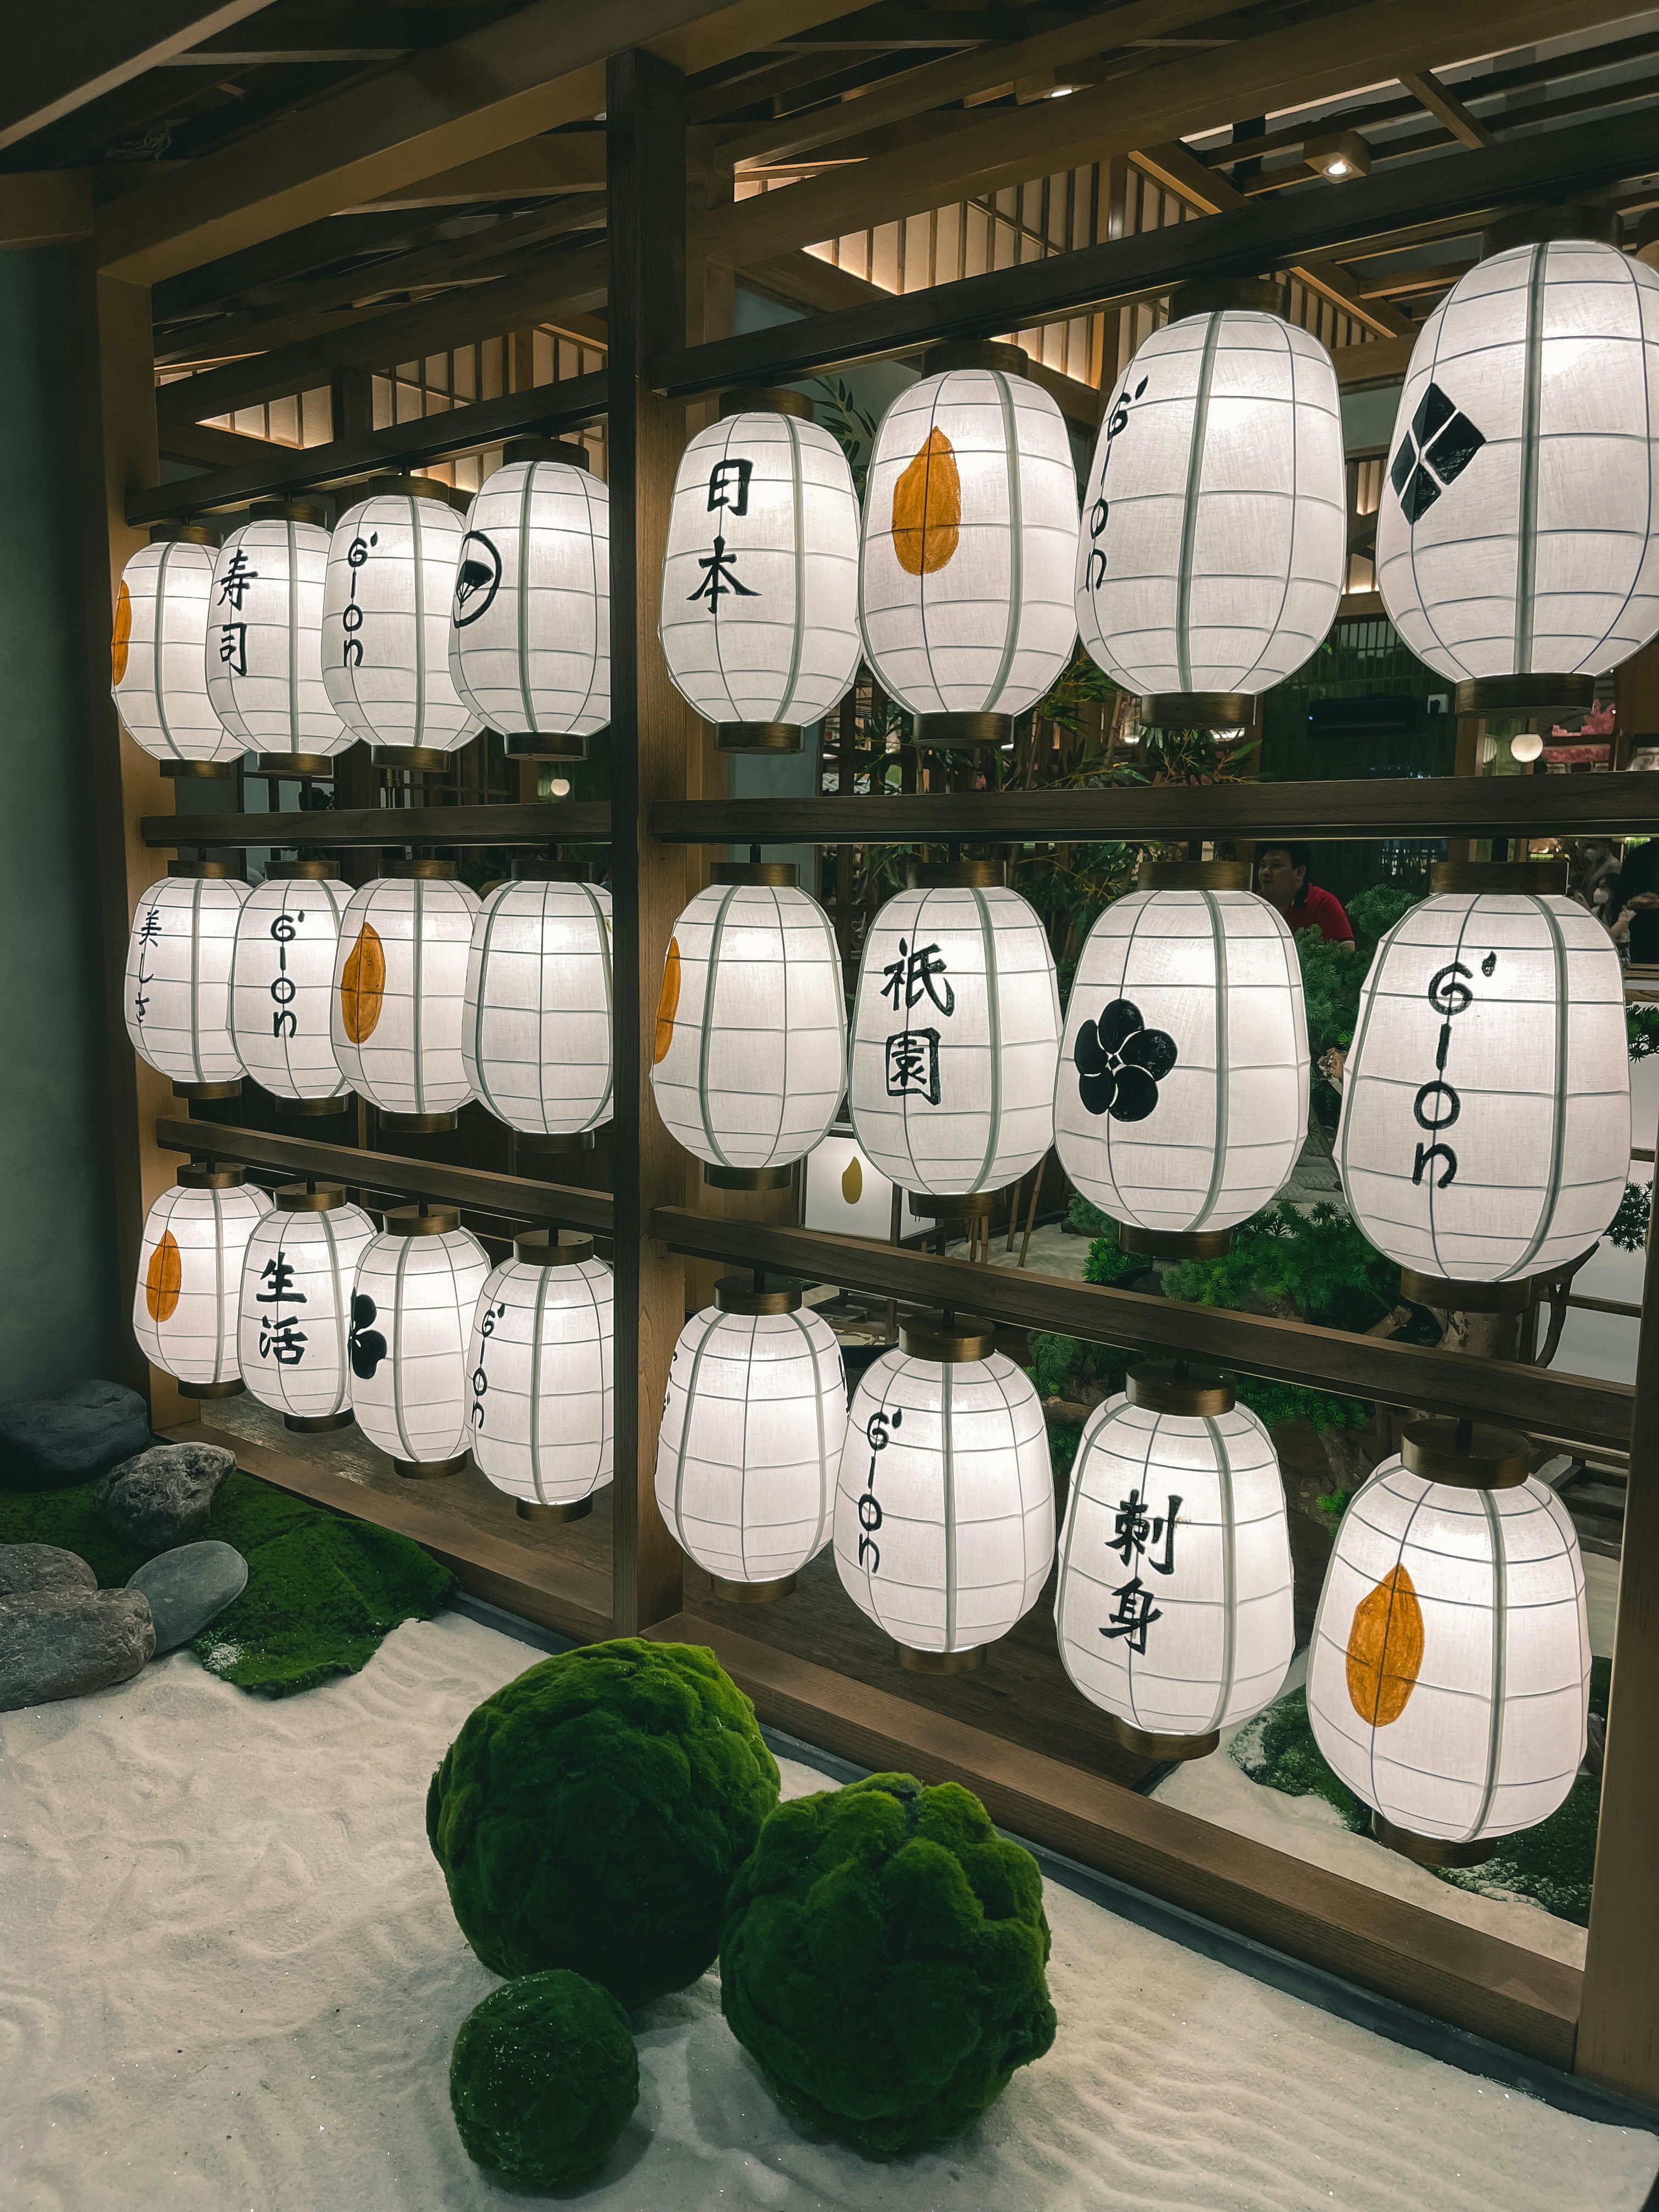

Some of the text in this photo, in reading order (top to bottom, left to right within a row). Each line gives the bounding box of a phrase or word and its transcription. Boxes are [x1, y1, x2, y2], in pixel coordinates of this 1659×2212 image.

[686, 459, 762, 614] 日本
[217, 549, 258, 676] 寿司
[256, 1252, 309, 1365] 生活
[1098, 1488, 1183, 1656] 刺身
